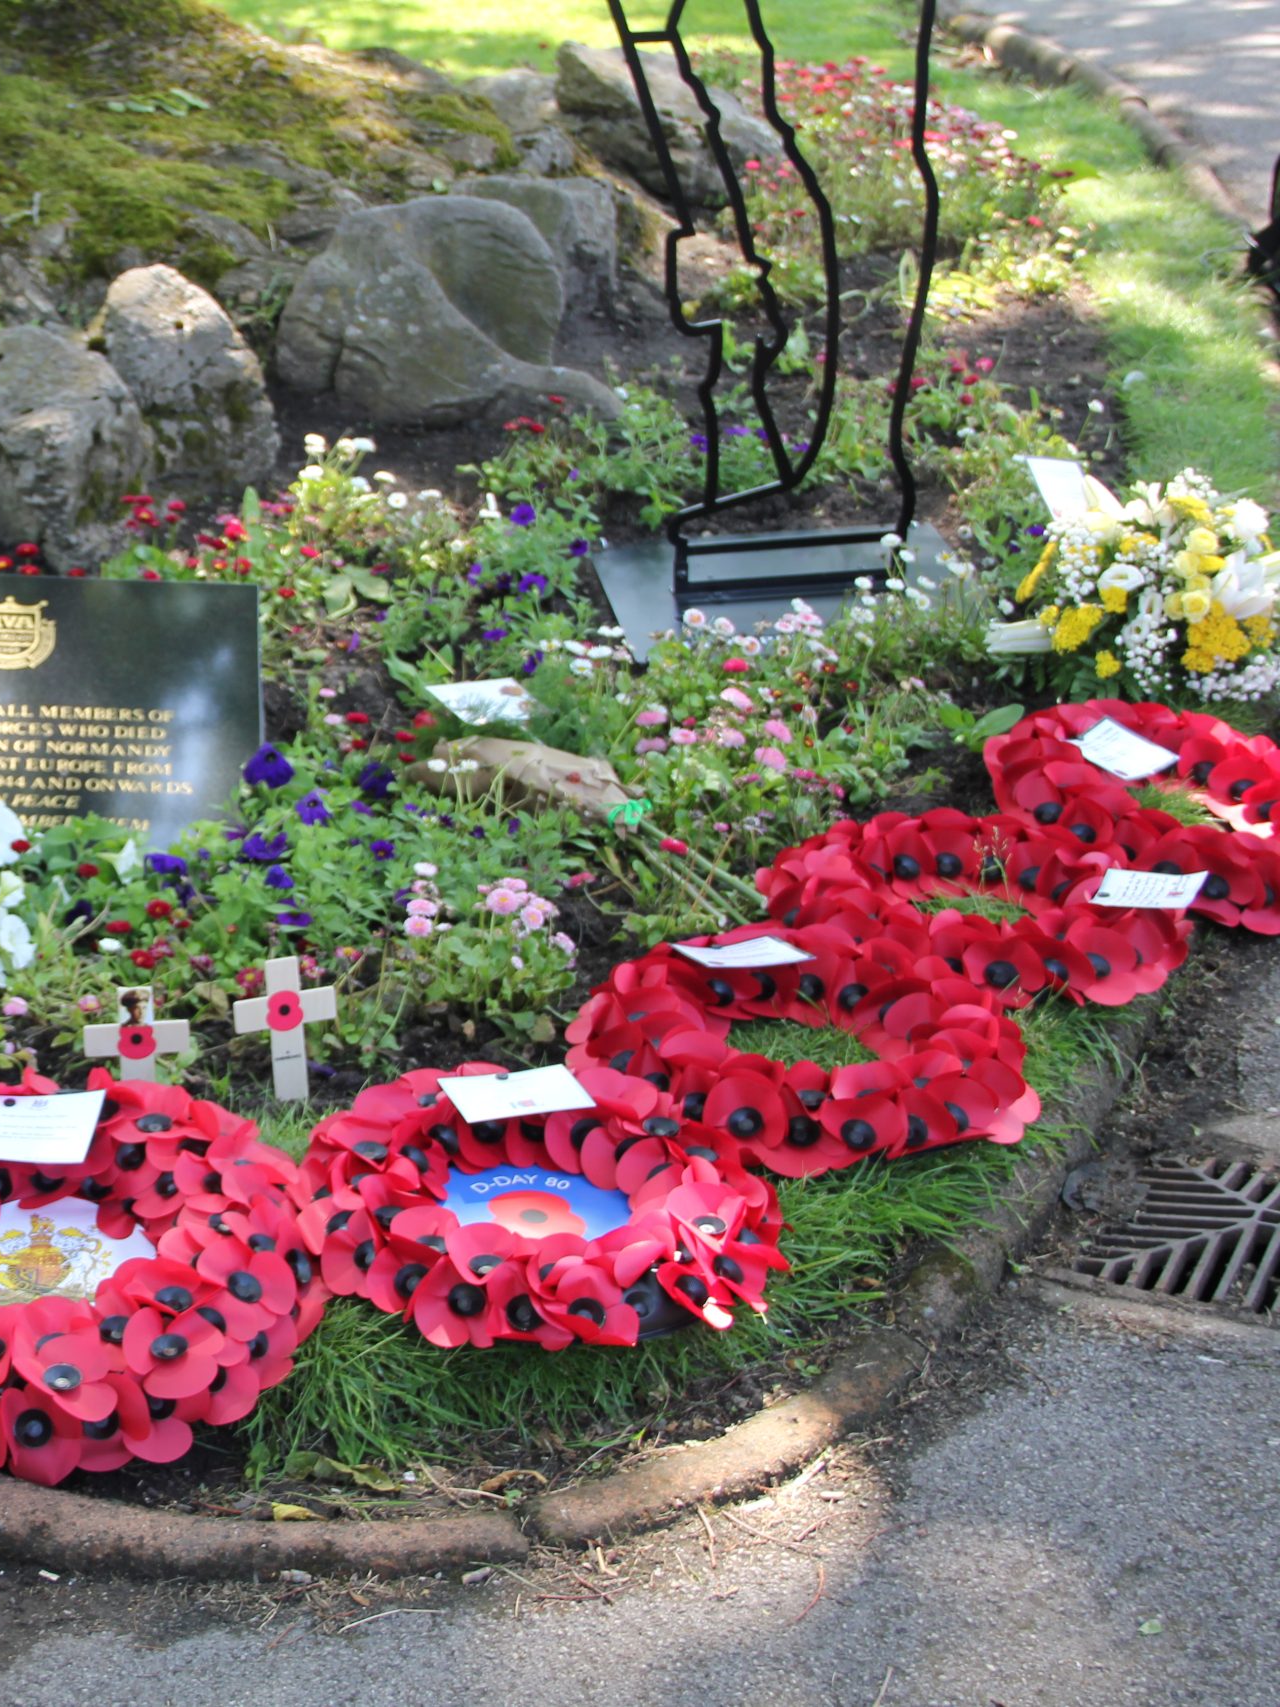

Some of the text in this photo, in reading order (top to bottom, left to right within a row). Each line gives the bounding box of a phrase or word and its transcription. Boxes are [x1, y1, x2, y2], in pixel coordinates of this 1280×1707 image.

[39, 705, 145, 721] MEMBERS
[148, 709, 175, 723] OF
[58, 724, 110, 738] WHO
[114, 726, 167, 740] DIED
[13, 739, 40, 753] OF
[46, 740, 172, 757] NORMANDY
[25, 758, 107, 774] EUROPE
[113, 761, 173, 776] FROM
[31, 777, 82, 791] AND
[85, 778, 193, 794] ONWARDS
[11, 794, 81, 810] PEACE
[470, 1174, 570, 1194] D-DAY 80
